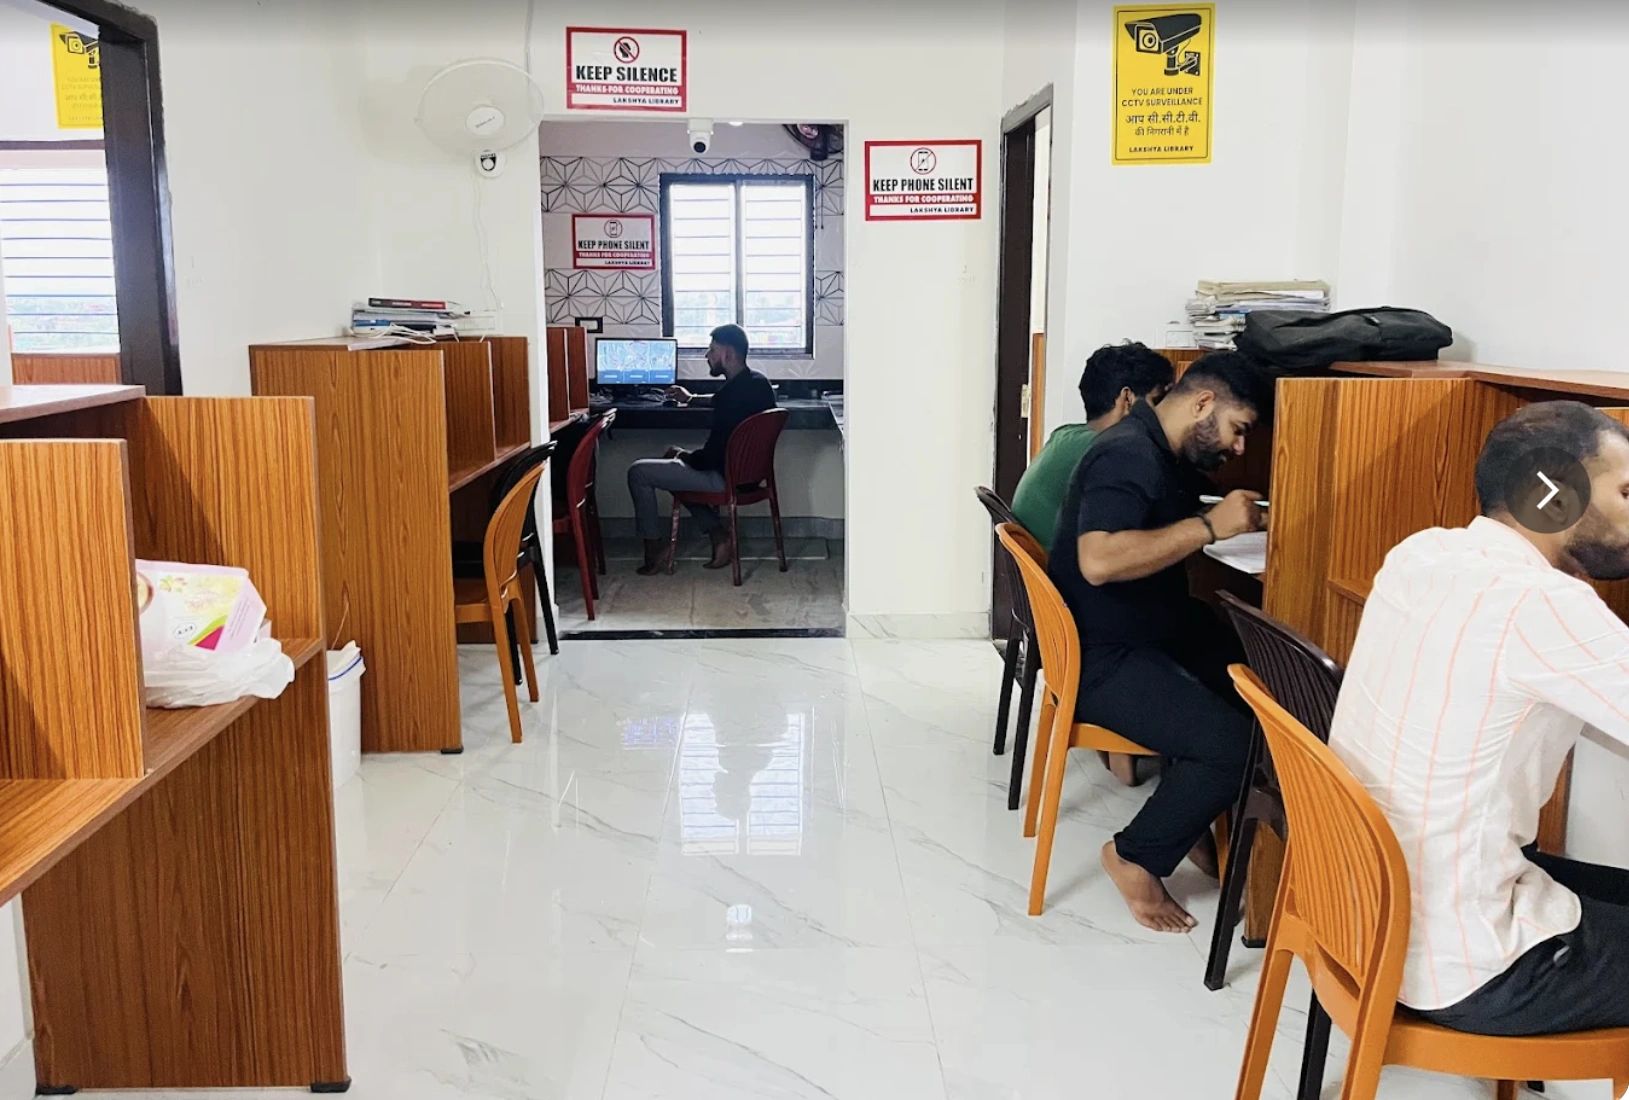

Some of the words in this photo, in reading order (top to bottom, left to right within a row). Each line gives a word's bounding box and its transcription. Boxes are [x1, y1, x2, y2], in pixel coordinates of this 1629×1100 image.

[576, 65, 612, 80] KEEP
[616, 66, 677, 82] SILENCE
[575, 84, 606, 93] THANKS
[608, 85, 624, 94] FOR
[624, 86, 679, 95] COOPERATING
[1132, 88, 1148, 96] YOU
[1167, 87, 1193, 95] UNDER
[1121, 99, 1144, 107] CCTV
[1146, 97, 1202, 106] SURVEILLANCE
[1126, 115, 1144, 123] आप
[873, 179, 898, 192] KEEP
[901, 178, 935, 191] PHONE
[938, 177, 973, 190] SILENT
[873, 195, 903, 203] THANKS
[905, 195, 920, 203] FOR
[921, 194, 974, 203] COOPERATING
[578, 240, 596, 249] KEEP
[598, 240, 622, 249] PHONE
[623, 240, 649, 249] SILENT
